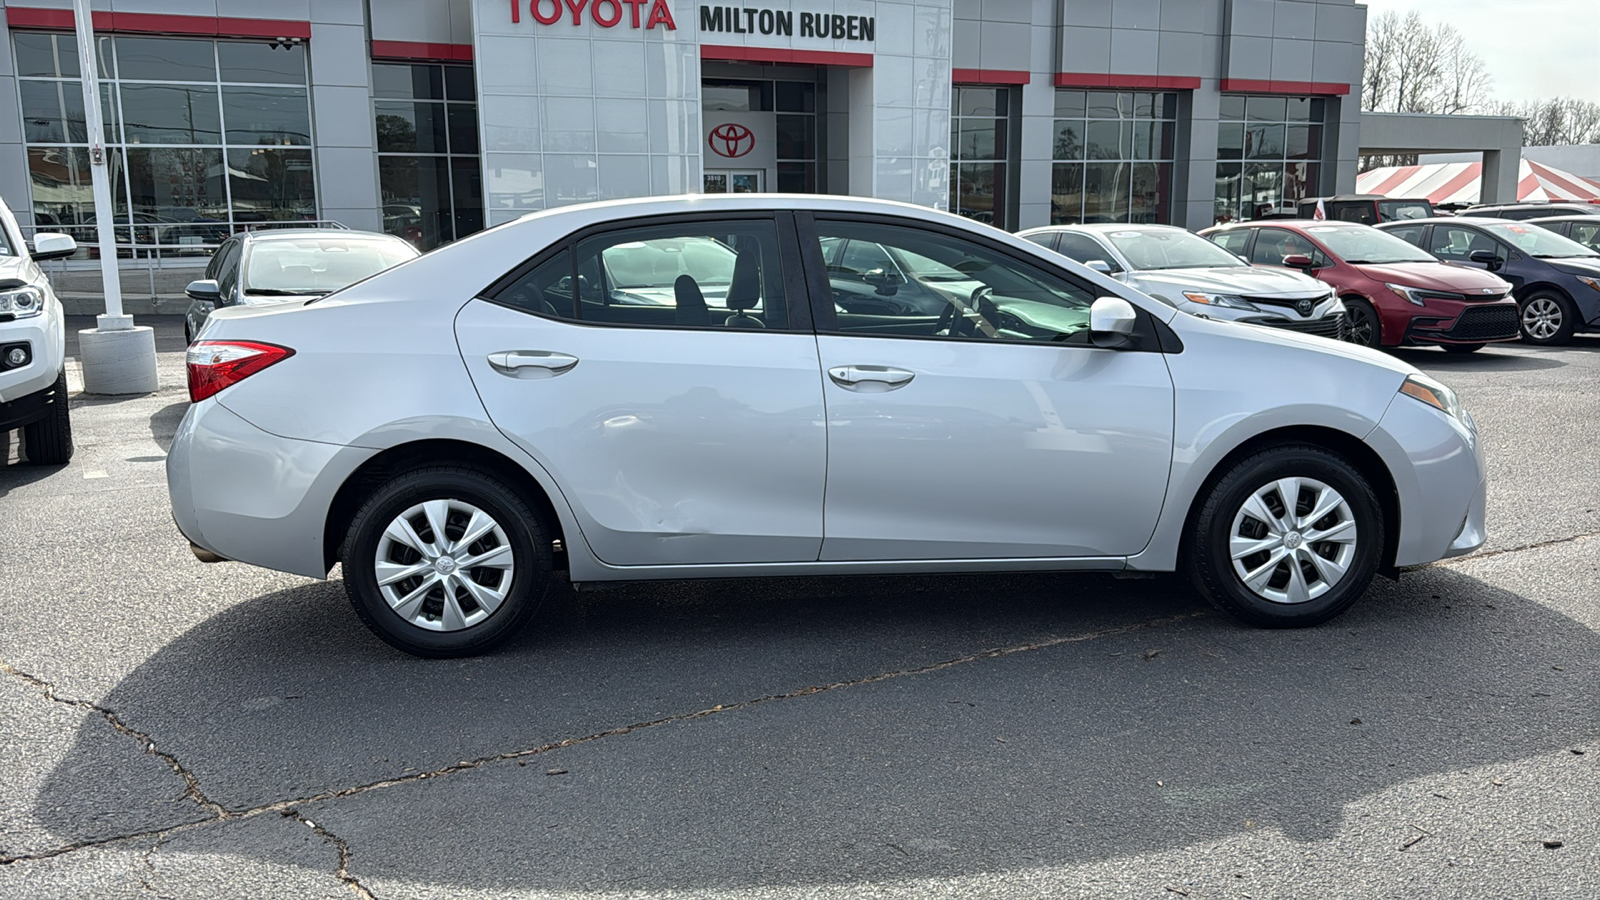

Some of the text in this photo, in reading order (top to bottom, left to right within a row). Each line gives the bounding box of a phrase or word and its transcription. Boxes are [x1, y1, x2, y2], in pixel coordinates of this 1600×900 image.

[511, 0, 677, 30] TOYOTA
[700, 5, 875, 42] MILTON RUBEN
